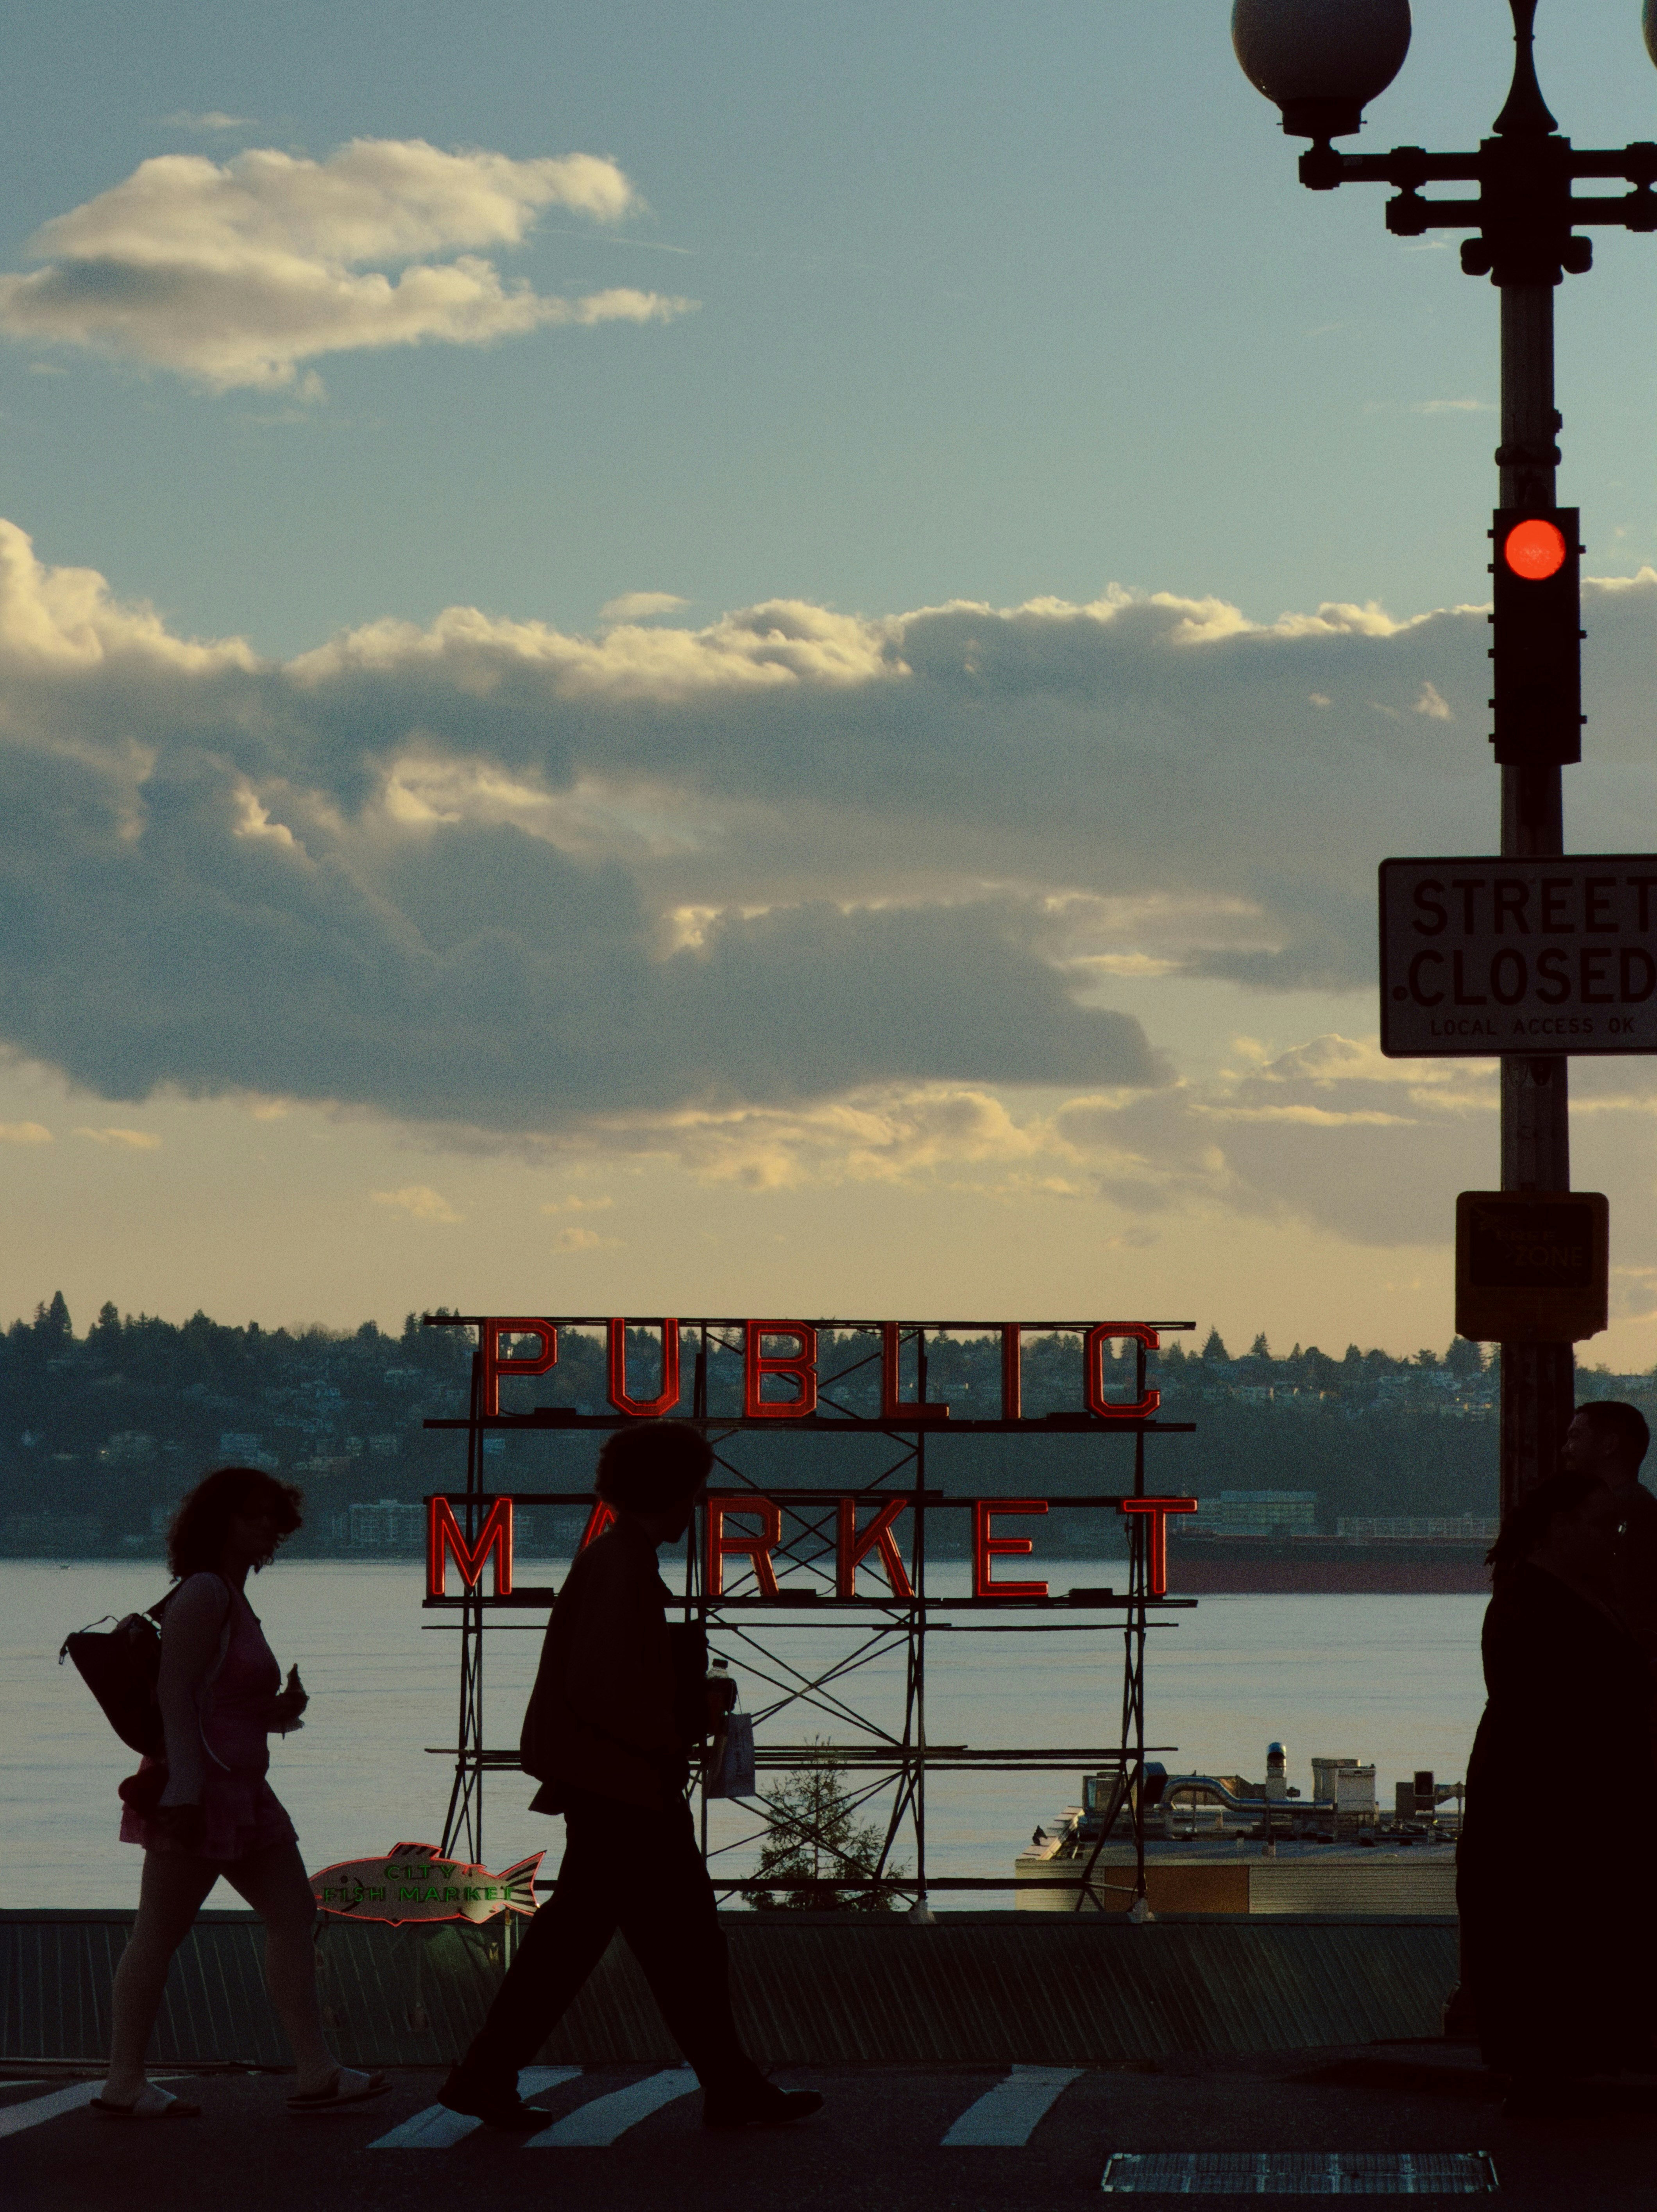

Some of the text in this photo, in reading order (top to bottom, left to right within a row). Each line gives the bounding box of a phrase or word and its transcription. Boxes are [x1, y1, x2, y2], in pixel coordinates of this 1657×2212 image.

[1412, 877, 1657, 935] STREET
[1409, 948, 1656, 1006] CLOSED
[1431, 1017, 1635, 1036] LOCAL ACCESS OK
[1514, 1246, 1583, 1267] ZONE
[483, 1318, 1160, 1420] PUBLIC
[428, 1496, 1197, 1600] MRKET
[384, 1864, 456, 1880] CITY
[324, 1887, 514, 1903] FISH MARKET
